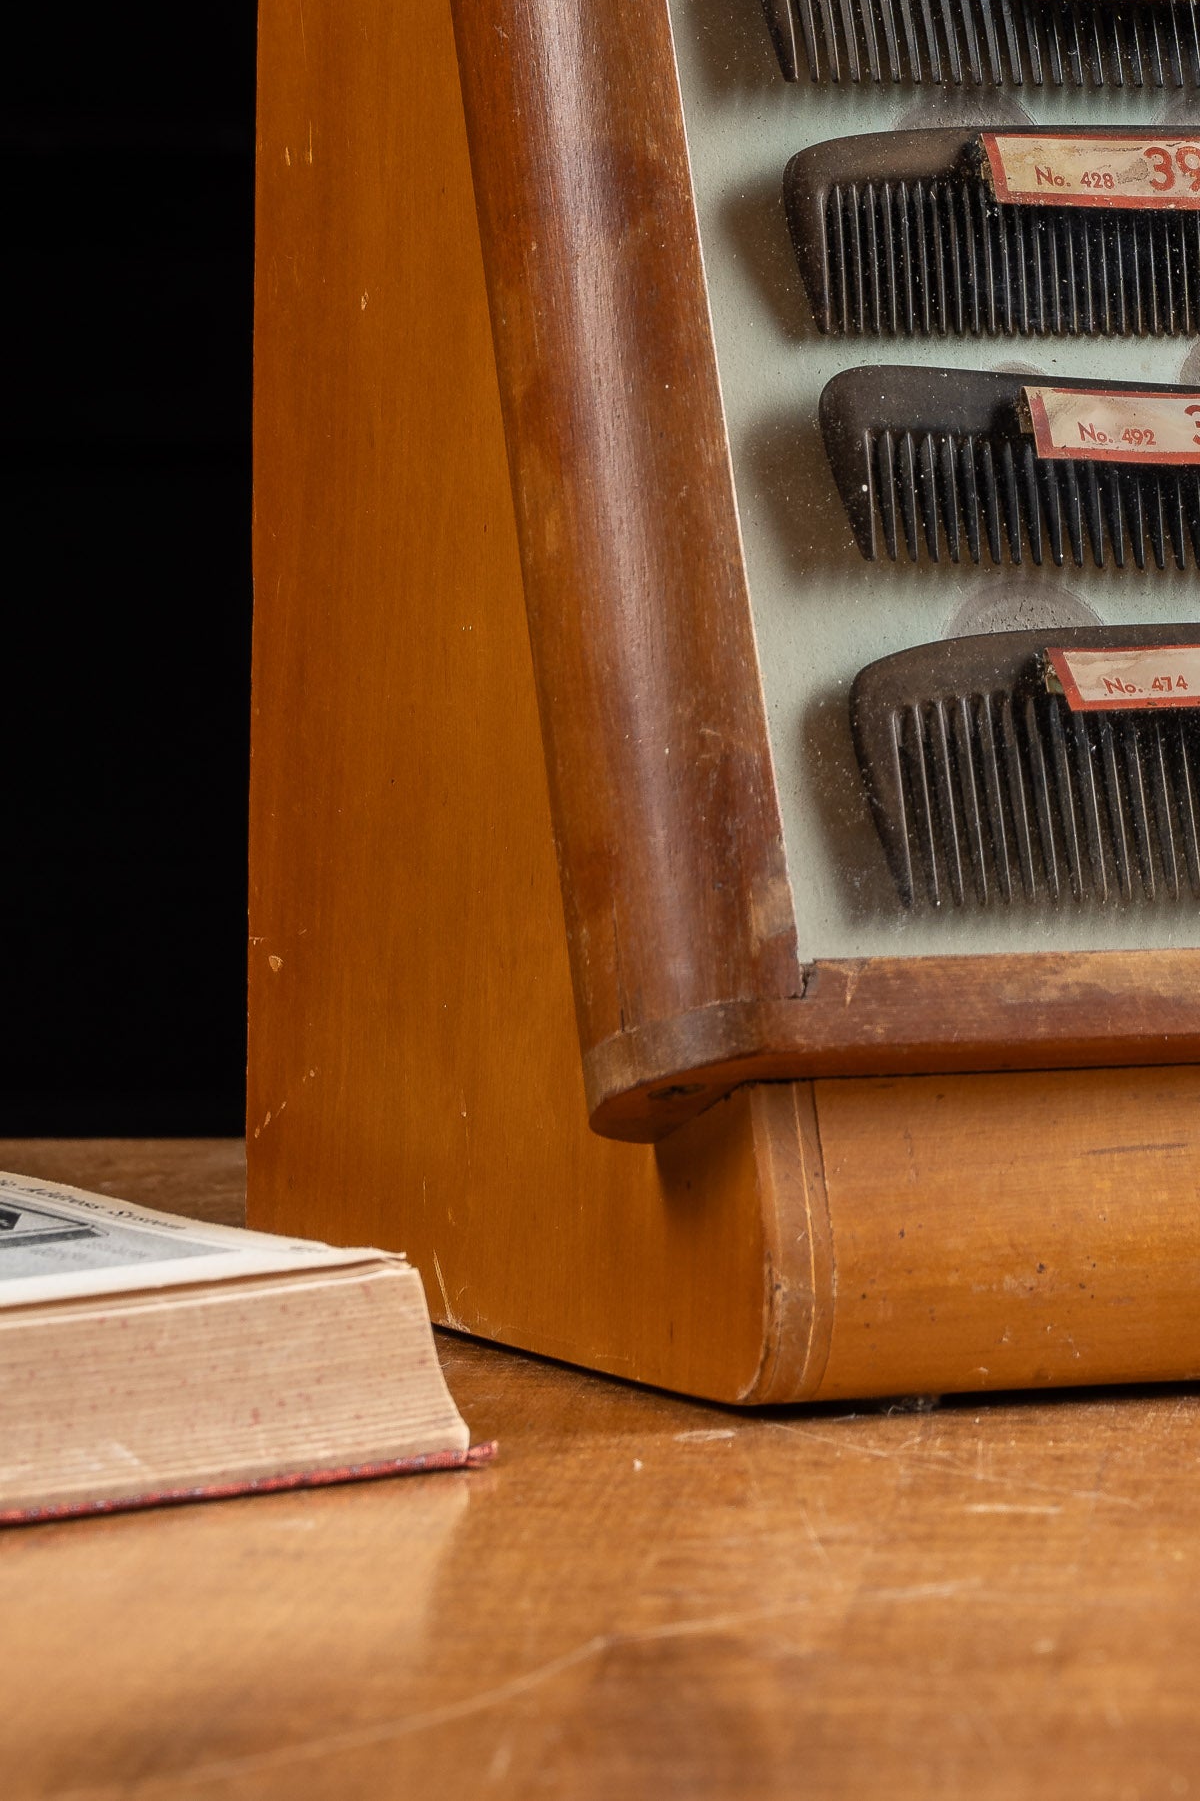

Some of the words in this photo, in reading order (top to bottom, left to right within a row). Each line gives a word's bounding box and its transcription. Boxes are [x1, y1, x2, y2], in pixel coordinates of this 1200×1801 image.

[1034, 165, 1071, 188] No.
[1079, 172, 1115, 189] 428
[1078, 422, 1115, 445] No.
[1120, 428, 1157, 446] 492
[1102, 676, 1144, 695] No.
[1151, 674, 1189, 692] 474
